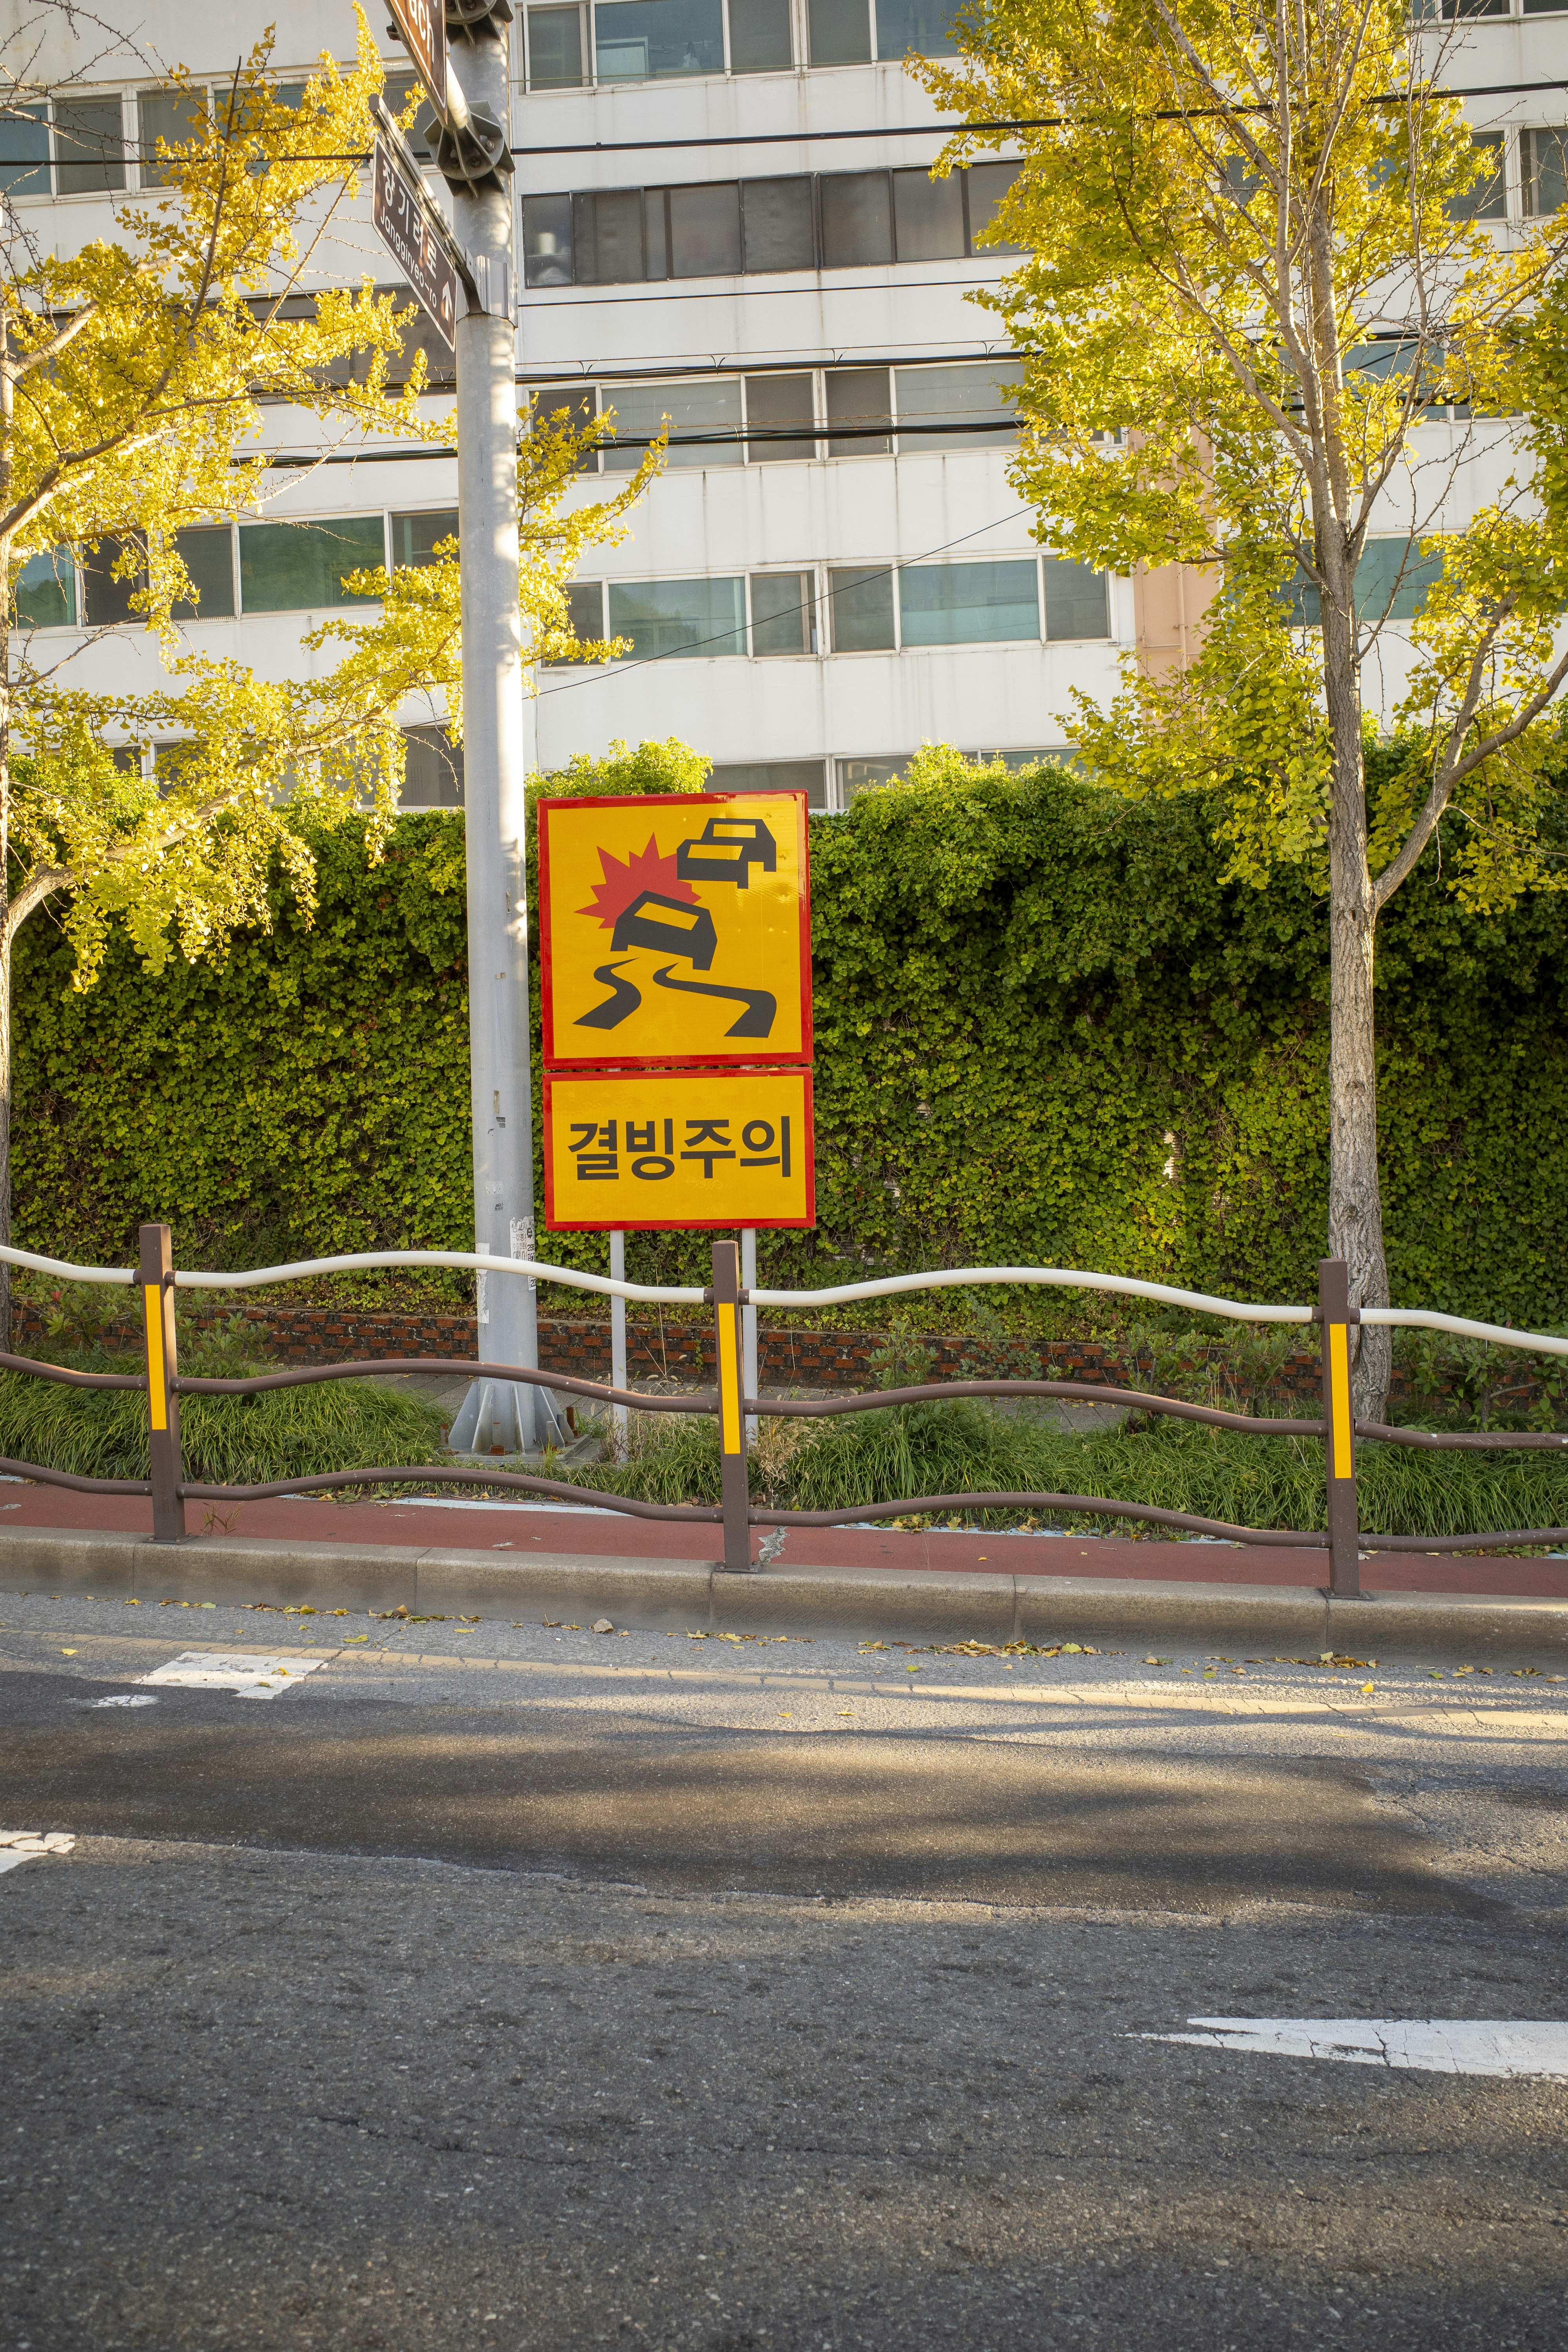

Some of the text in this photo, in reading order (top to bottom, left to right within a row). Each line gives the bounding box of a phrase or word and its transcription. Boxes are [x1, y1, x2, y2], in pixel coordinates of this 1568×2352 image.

[380, 205, 437, 309] Janggiryeo-ro
[383, 158, 437, 280] 장기려로
[567, 1116, 791, 1181] 결빙주의
